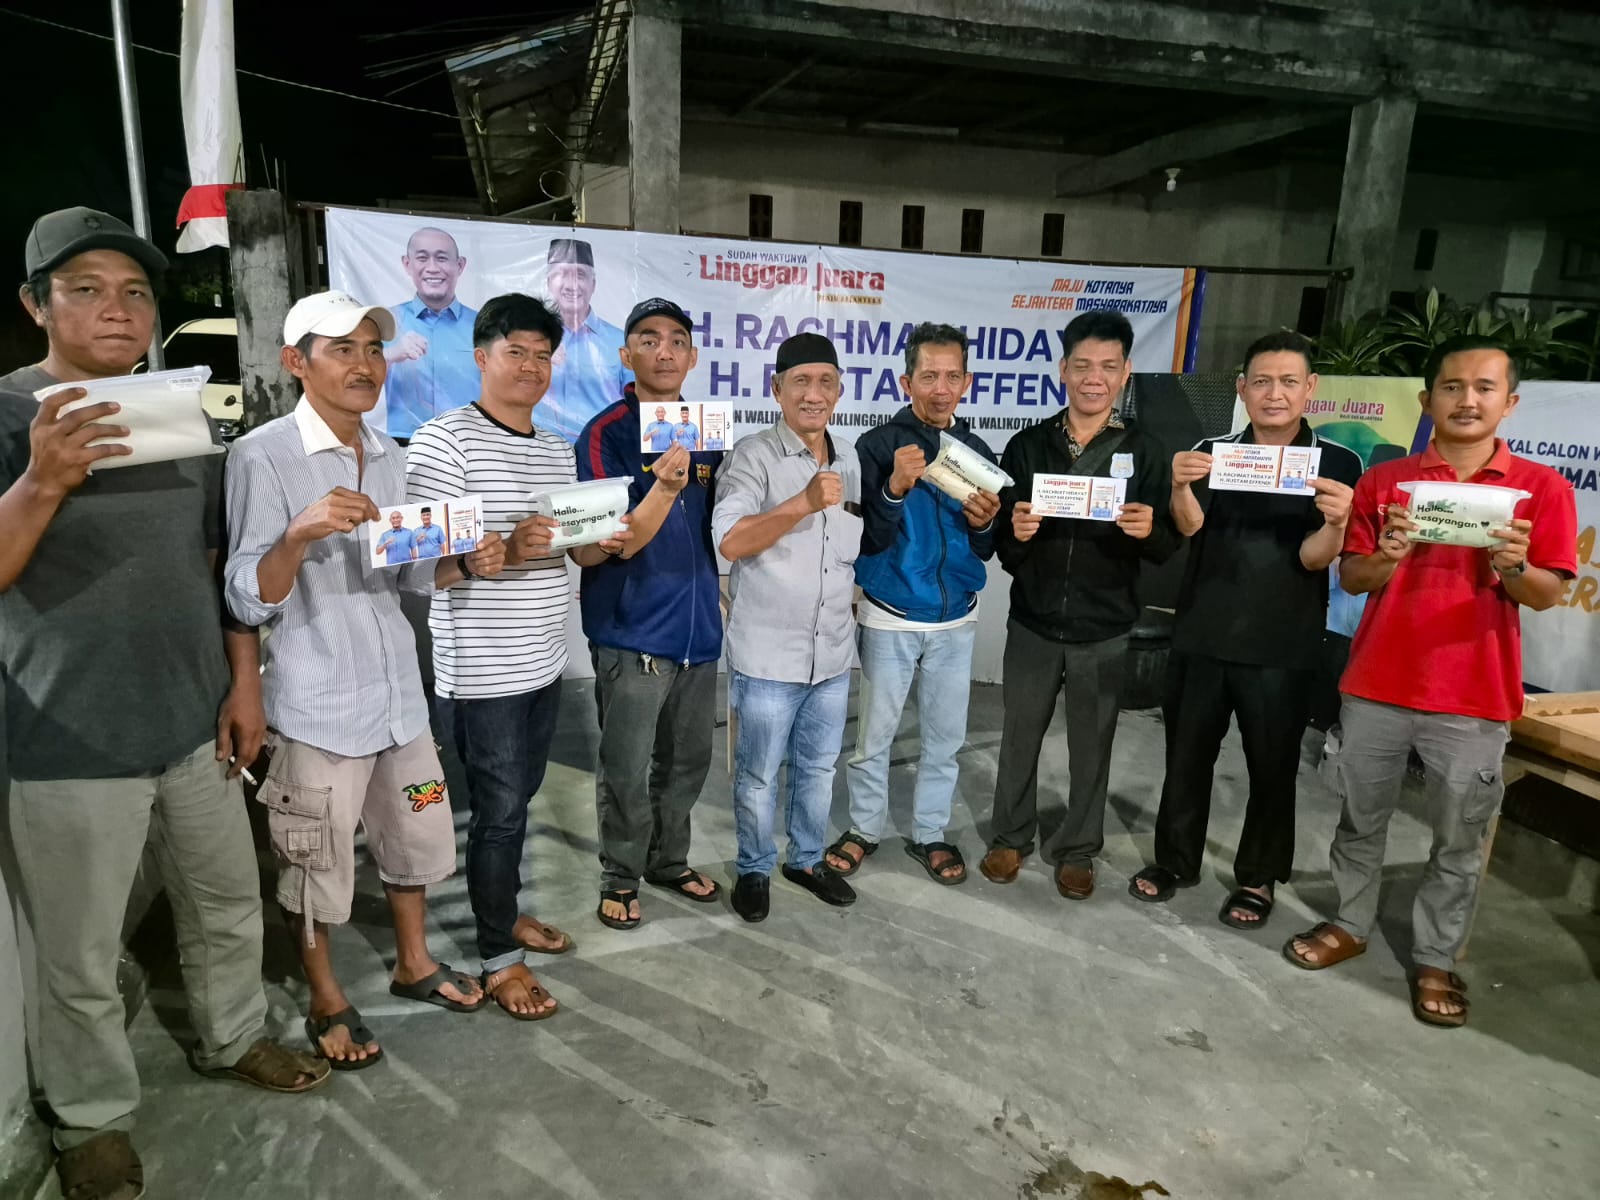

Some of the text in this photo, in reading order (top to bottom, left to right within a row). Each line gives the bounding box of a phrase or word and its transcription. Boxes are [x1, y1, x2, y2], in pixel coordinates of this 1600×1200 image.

[727, 250, 807, 264] SUDAH WAKTUNYA
[700, 254, 885, 292] Linggau Juara
[1051, 278, 1134, 295] MAJU KOTANYA
[1011, 295, 1168, 314] SEJAHTERA MASYARAKATNYA
[710, 361, 751, 397] H.
[1303, 398, 1385, 416] ggau Juara
[1507, 438, 1533, 454] KAL
[1537, 441, 1589, 460] CALON
[553, 506, 585, 517] Hallo...
[1417, 504, 1454, 514] Hallo...
[559, 514, 607, 528] esayangan
